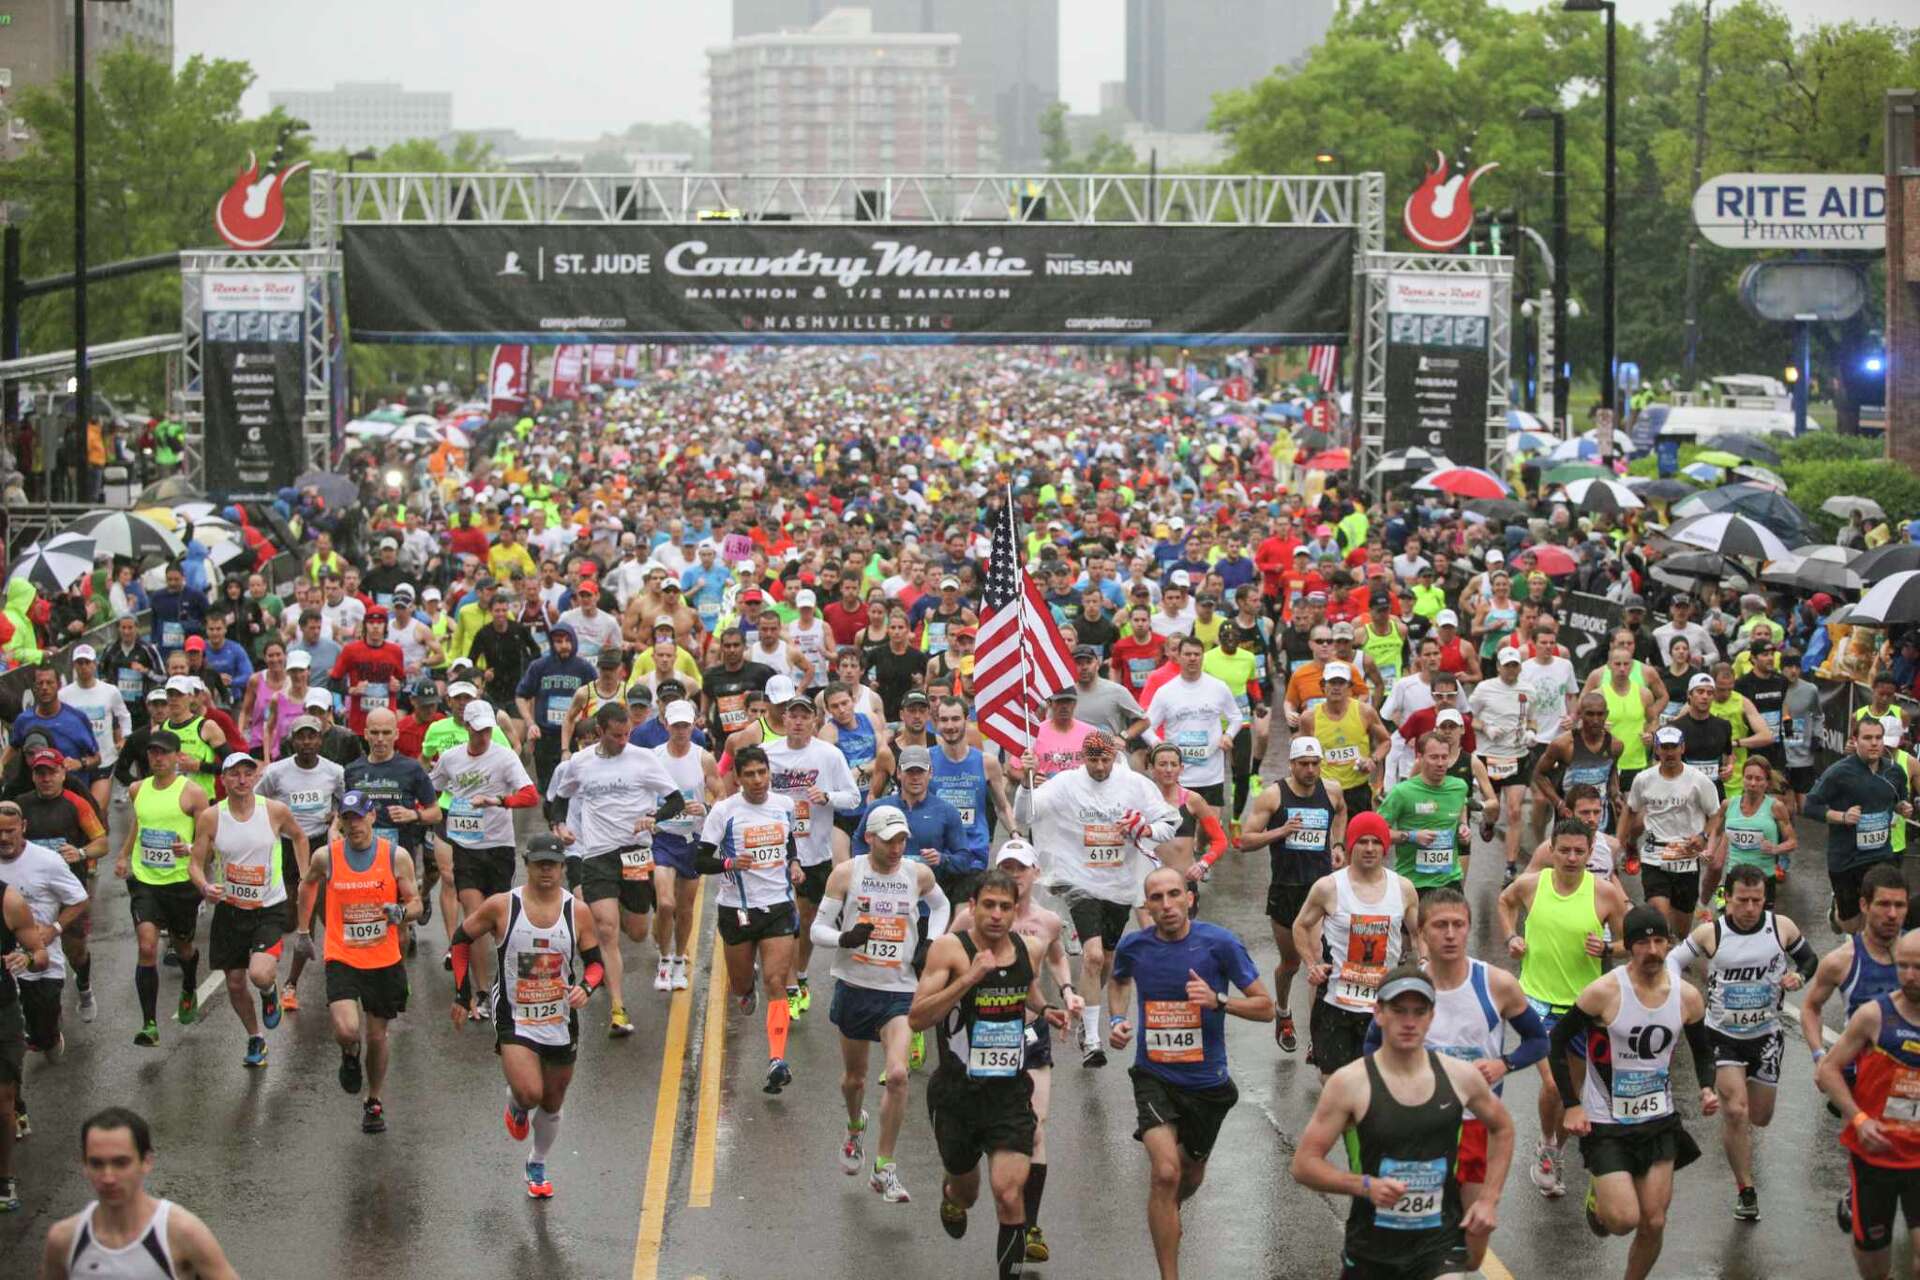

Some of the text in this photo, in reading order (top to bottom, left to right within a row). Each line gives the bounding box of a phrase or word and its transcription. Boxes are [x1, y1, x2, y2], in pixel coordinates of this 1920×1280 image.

[1716, 186, 1886, 217] RITE AID
[1743, 218, 1868, 240] PHARMACY
[554, 241, 1133, 287] ST. JUDE Country Music NISSAN
[685, 287, 1011, 299] MARATHON & 1/2 MARATHON
[539, 316, 626, 330] competitor.com
[1065, 316, 1152, 330] competitor.com
[1329, 748, 1355, 760] 9153
[291, 791, 320, 803] 9938
[454, 819, 479, 830] 1434
[1734, 832, 1755, 844] 302
[144, 849, 171, 863] 1292
[752, 847, 780, 861] 1073
[1090, 848, 1120, 860] 6191
[1424, 852, 1449, 864] 1304
[1666, 860, 1692, 871] 1177
[231, 884, 259, 899] 1086
[861, 879, 909, 890] MARATHON
[349, 924, 381, 938] 1096
[525, 1003, 558, 1018] 1125
[1732, 1010, 1766, 1025] 1644
[1149, 1015, 1198, 1024] NASHVILLE
[1154, 1032, 1195, 1047] 1148
[979, 1052, 1018, 1067] 1356
[1623, 1096, 1659, 1115] 1645
[1391, 1194, 1434, 1213] 284
